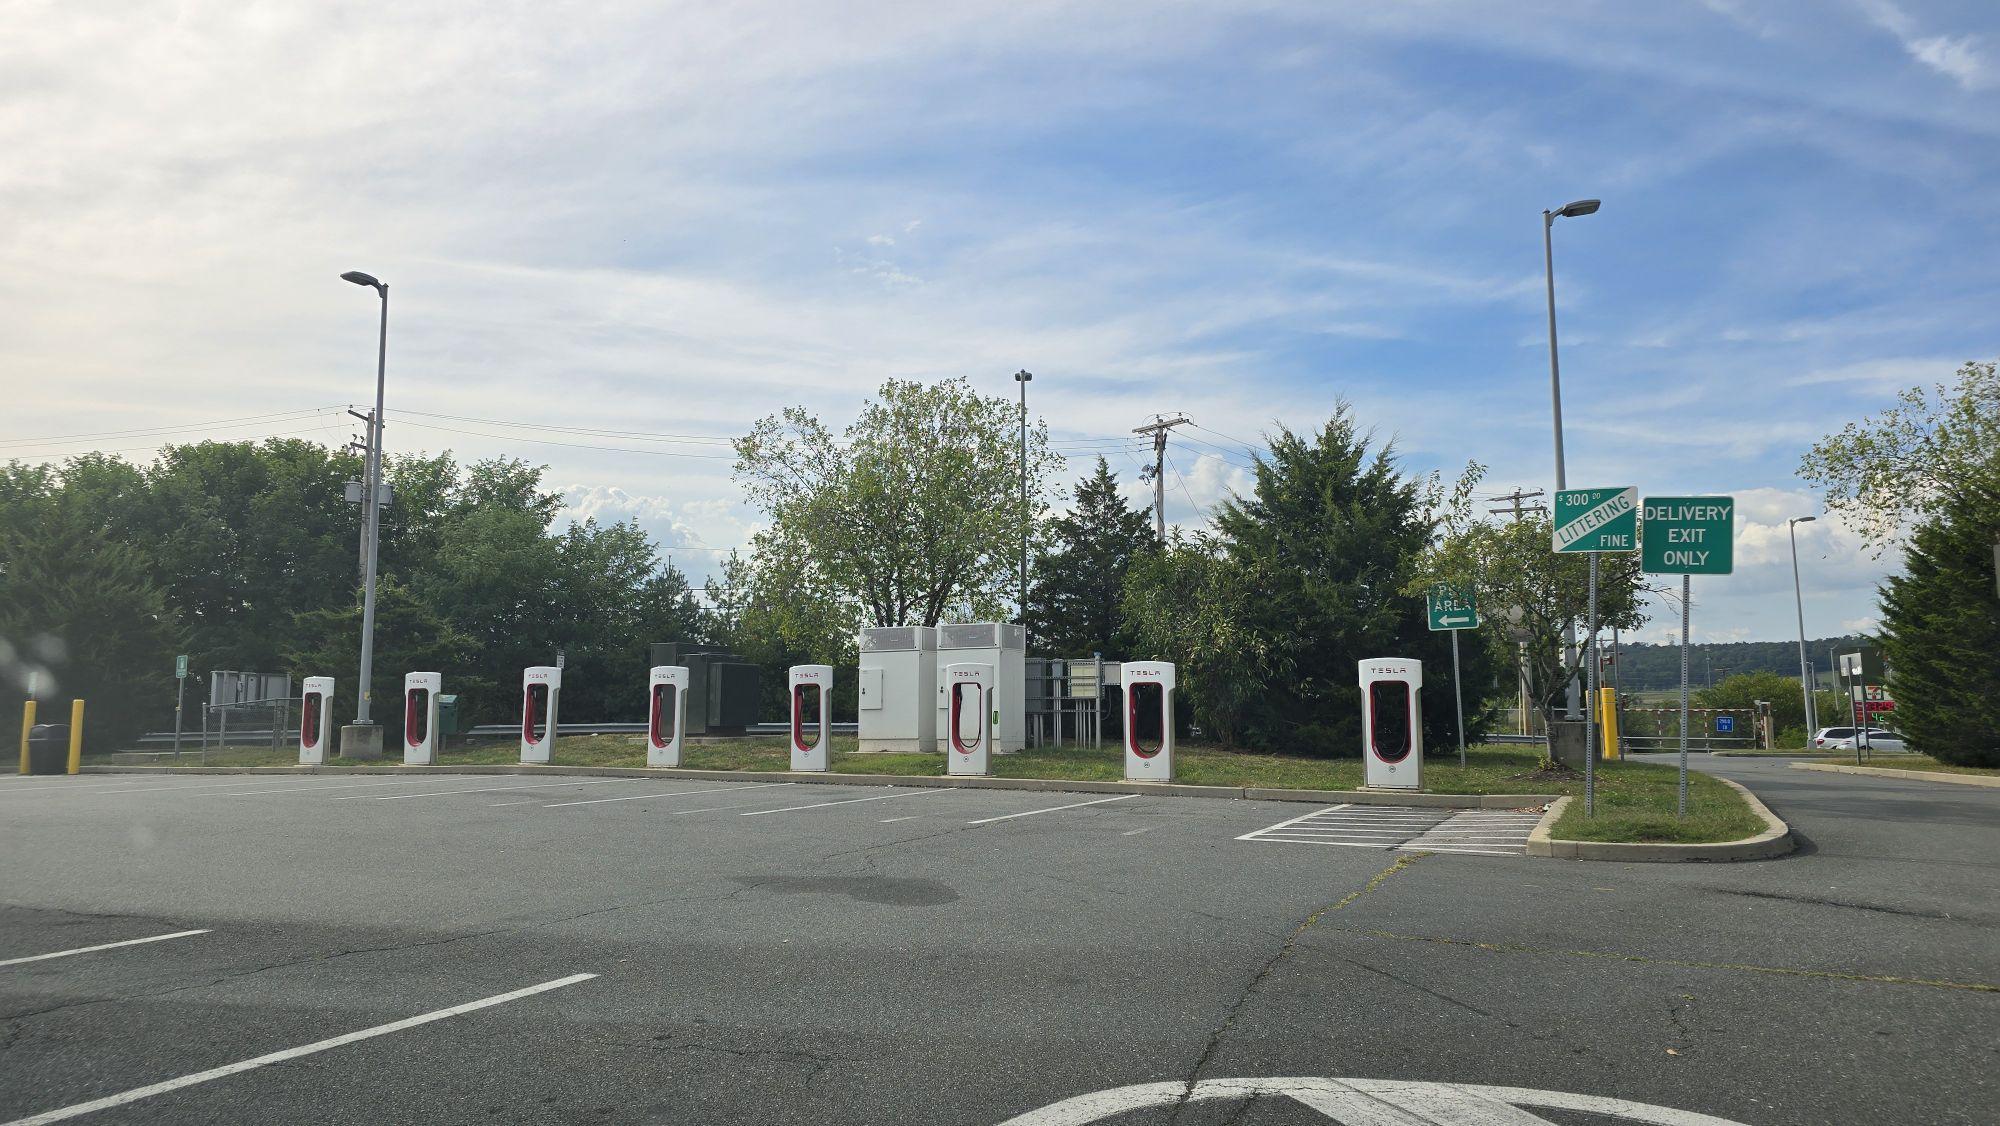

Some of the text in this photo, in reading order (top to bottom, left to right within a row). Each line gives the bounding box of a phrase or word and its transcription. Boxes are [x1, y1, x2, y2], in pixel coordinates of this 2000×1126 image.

[1565, 493, 1589, 506] 300
[1558, 495, 1630, 544] LITTERING
[1645, 506, 1731, 521] DELIVERY
[1600, 534, 1629, 547] FINE
[1668, 528, 1706, 543] EXIT
[1663, 550, 1710, 566] ONLY
